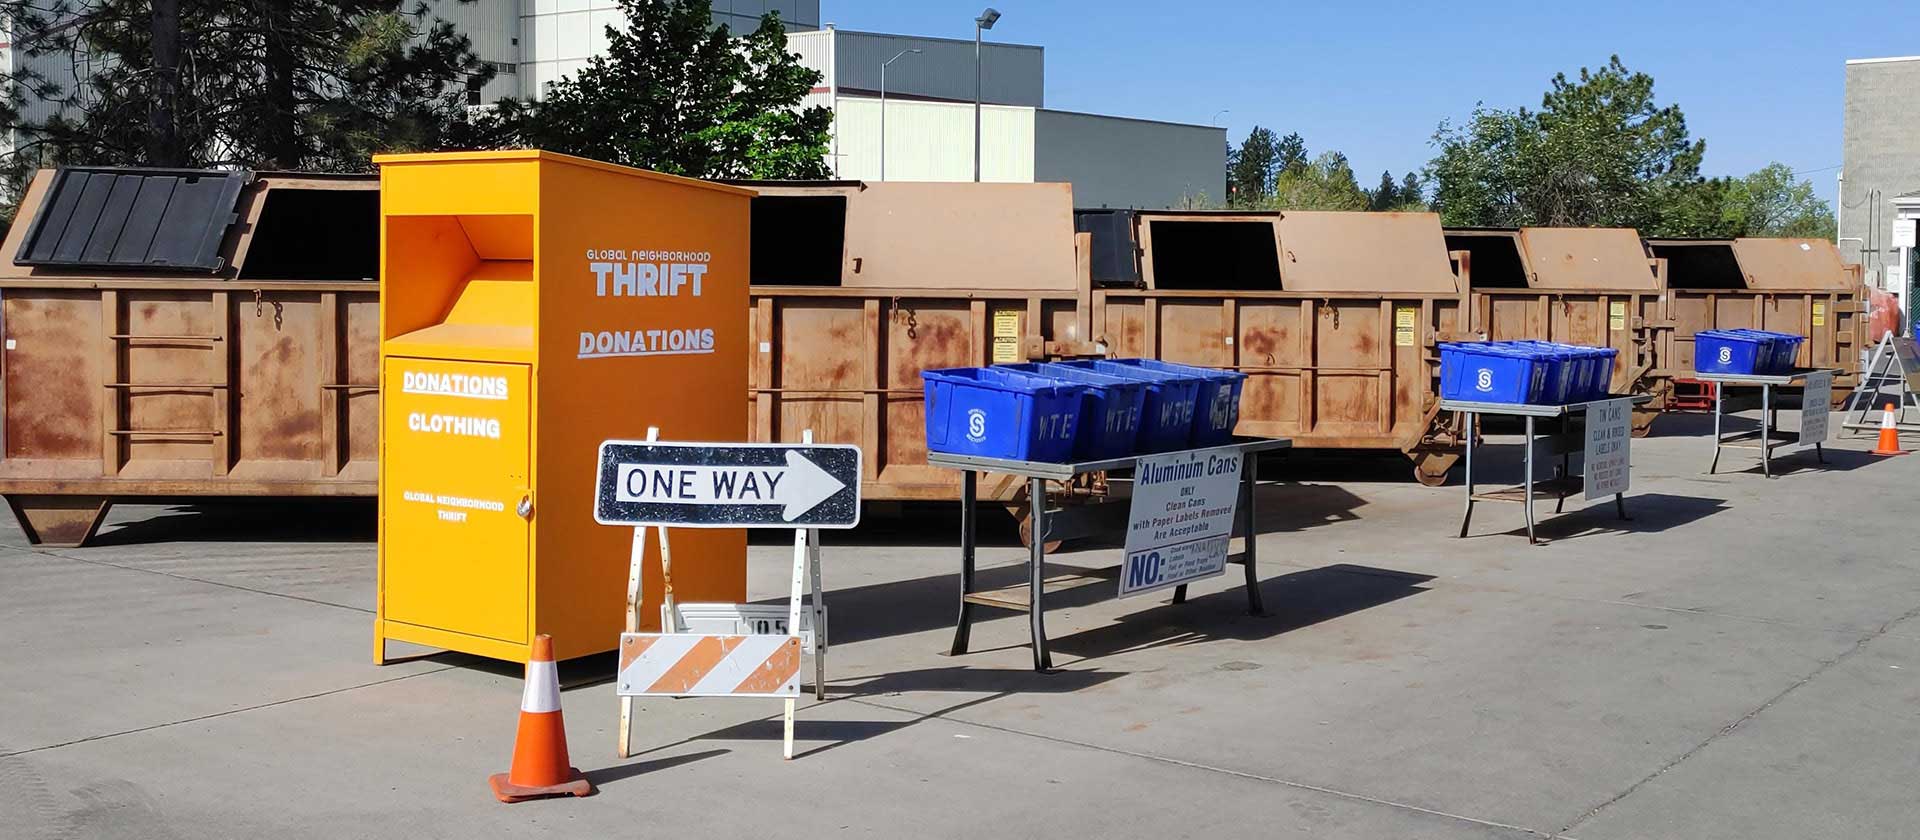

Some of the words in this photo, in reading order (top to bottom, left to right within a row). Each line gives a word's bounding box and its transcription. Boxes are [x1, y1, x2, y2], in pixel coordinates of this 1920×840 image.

[590, 262, 708, 297] THRIFT
[579, 328, 714, 354] DONATIONS
[403, 371, 508, 397] DONATIONS
[408, 412, 500, 438] CLOTHING
[1140, 459, 1203, 486] Aluminum
[1207, 455, 1238, 476] Cans
[626, 468, 697, 499] ONE
[712, 471, 785, 500] WAY
[403, 491, 434, 503] GLOBAL
[436, 496, 504, 512] NEIGHBORHOOD
[1166, 501, 1186, 511] Clean
[1188, 498, 1206, 508] Cans
[438, 509, 467, 522] THRIFT
[1133, 521, 1150, 531] with
[1152, 517, 1174, 528] Paper
[1175, 511, 1199, 523] Labels
[1201, 505, 1233, 518] Removed
[1154, 529, 1167, 540] Are
[1169, 521, 1209, 537] Acceptable
[1129, 551, 1166, 588] NO:
